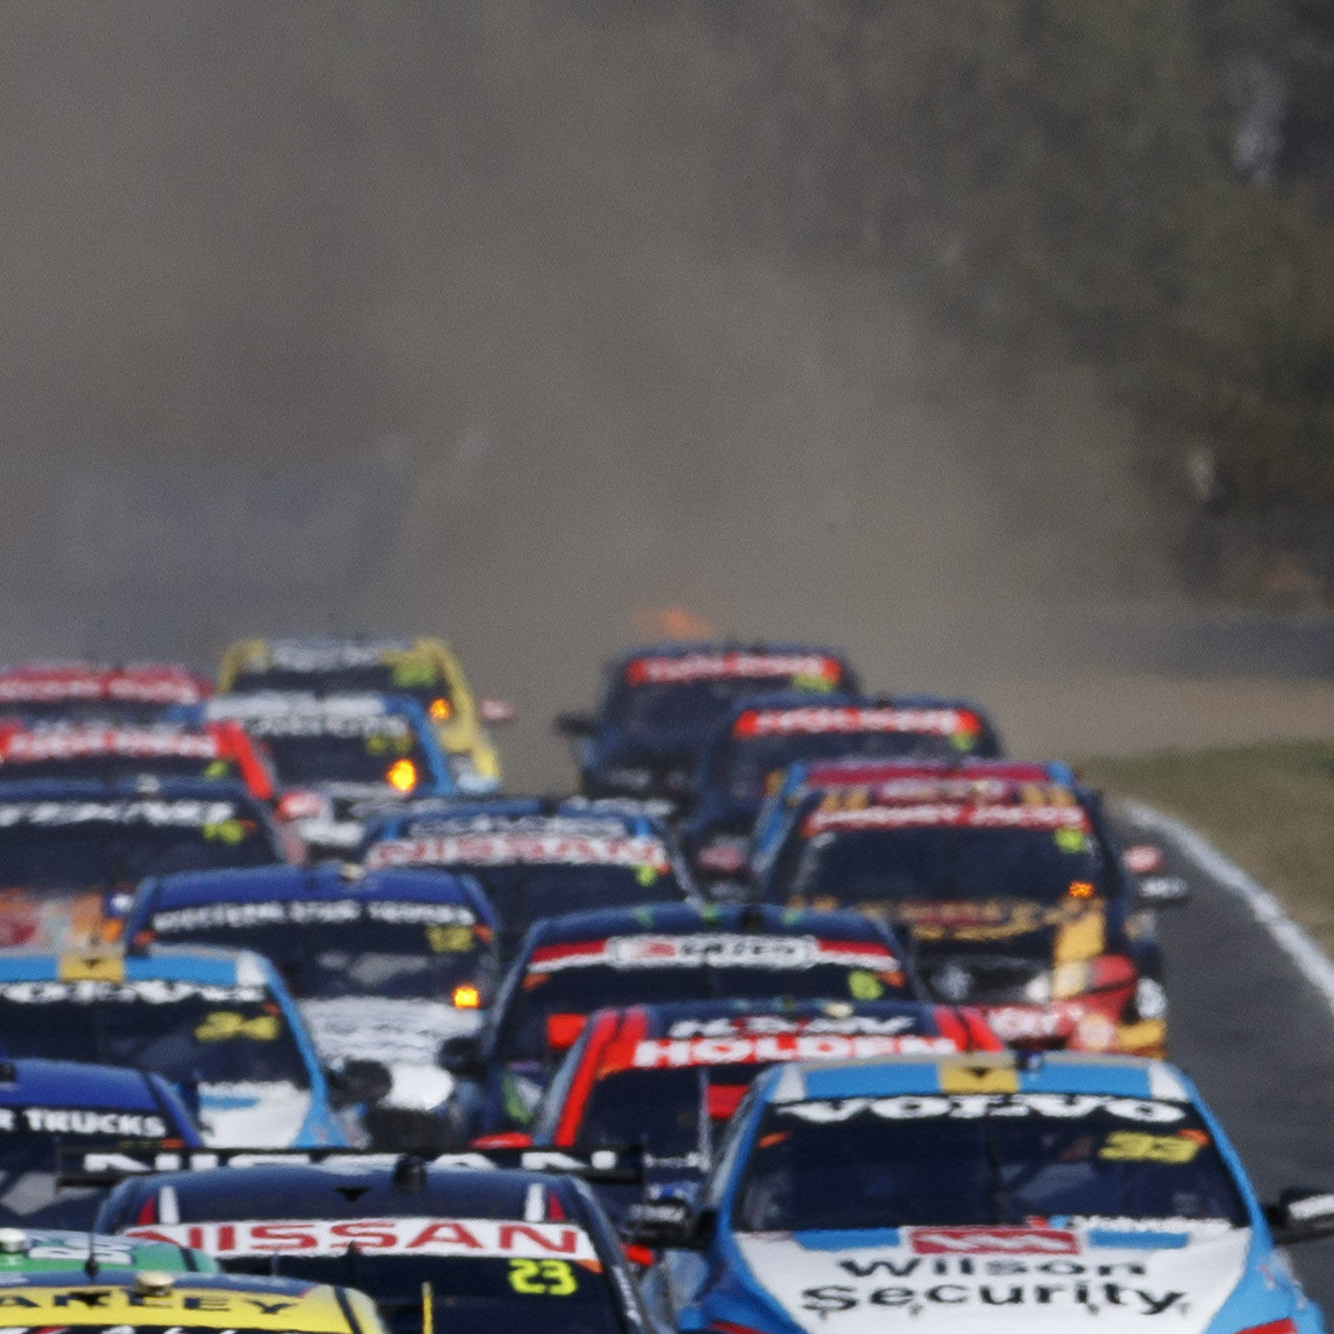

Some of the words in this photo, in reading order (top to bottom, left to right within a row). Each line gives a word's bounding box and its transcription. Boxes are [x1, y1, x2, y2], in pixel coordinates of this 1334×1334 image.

[633, 1035, 958, 1067] HOLDEN
[24, 1108, 166, 1136] TRUCKS
[776, 1095, 1185, 1122] VOLVO
[125, 1221, 578, 1253] NISSAN
[508, 1257, 578, 1296] 23
[837, 1256, 1147, 1278] Wilson
[801, 1282, 1189, 1316] Security
